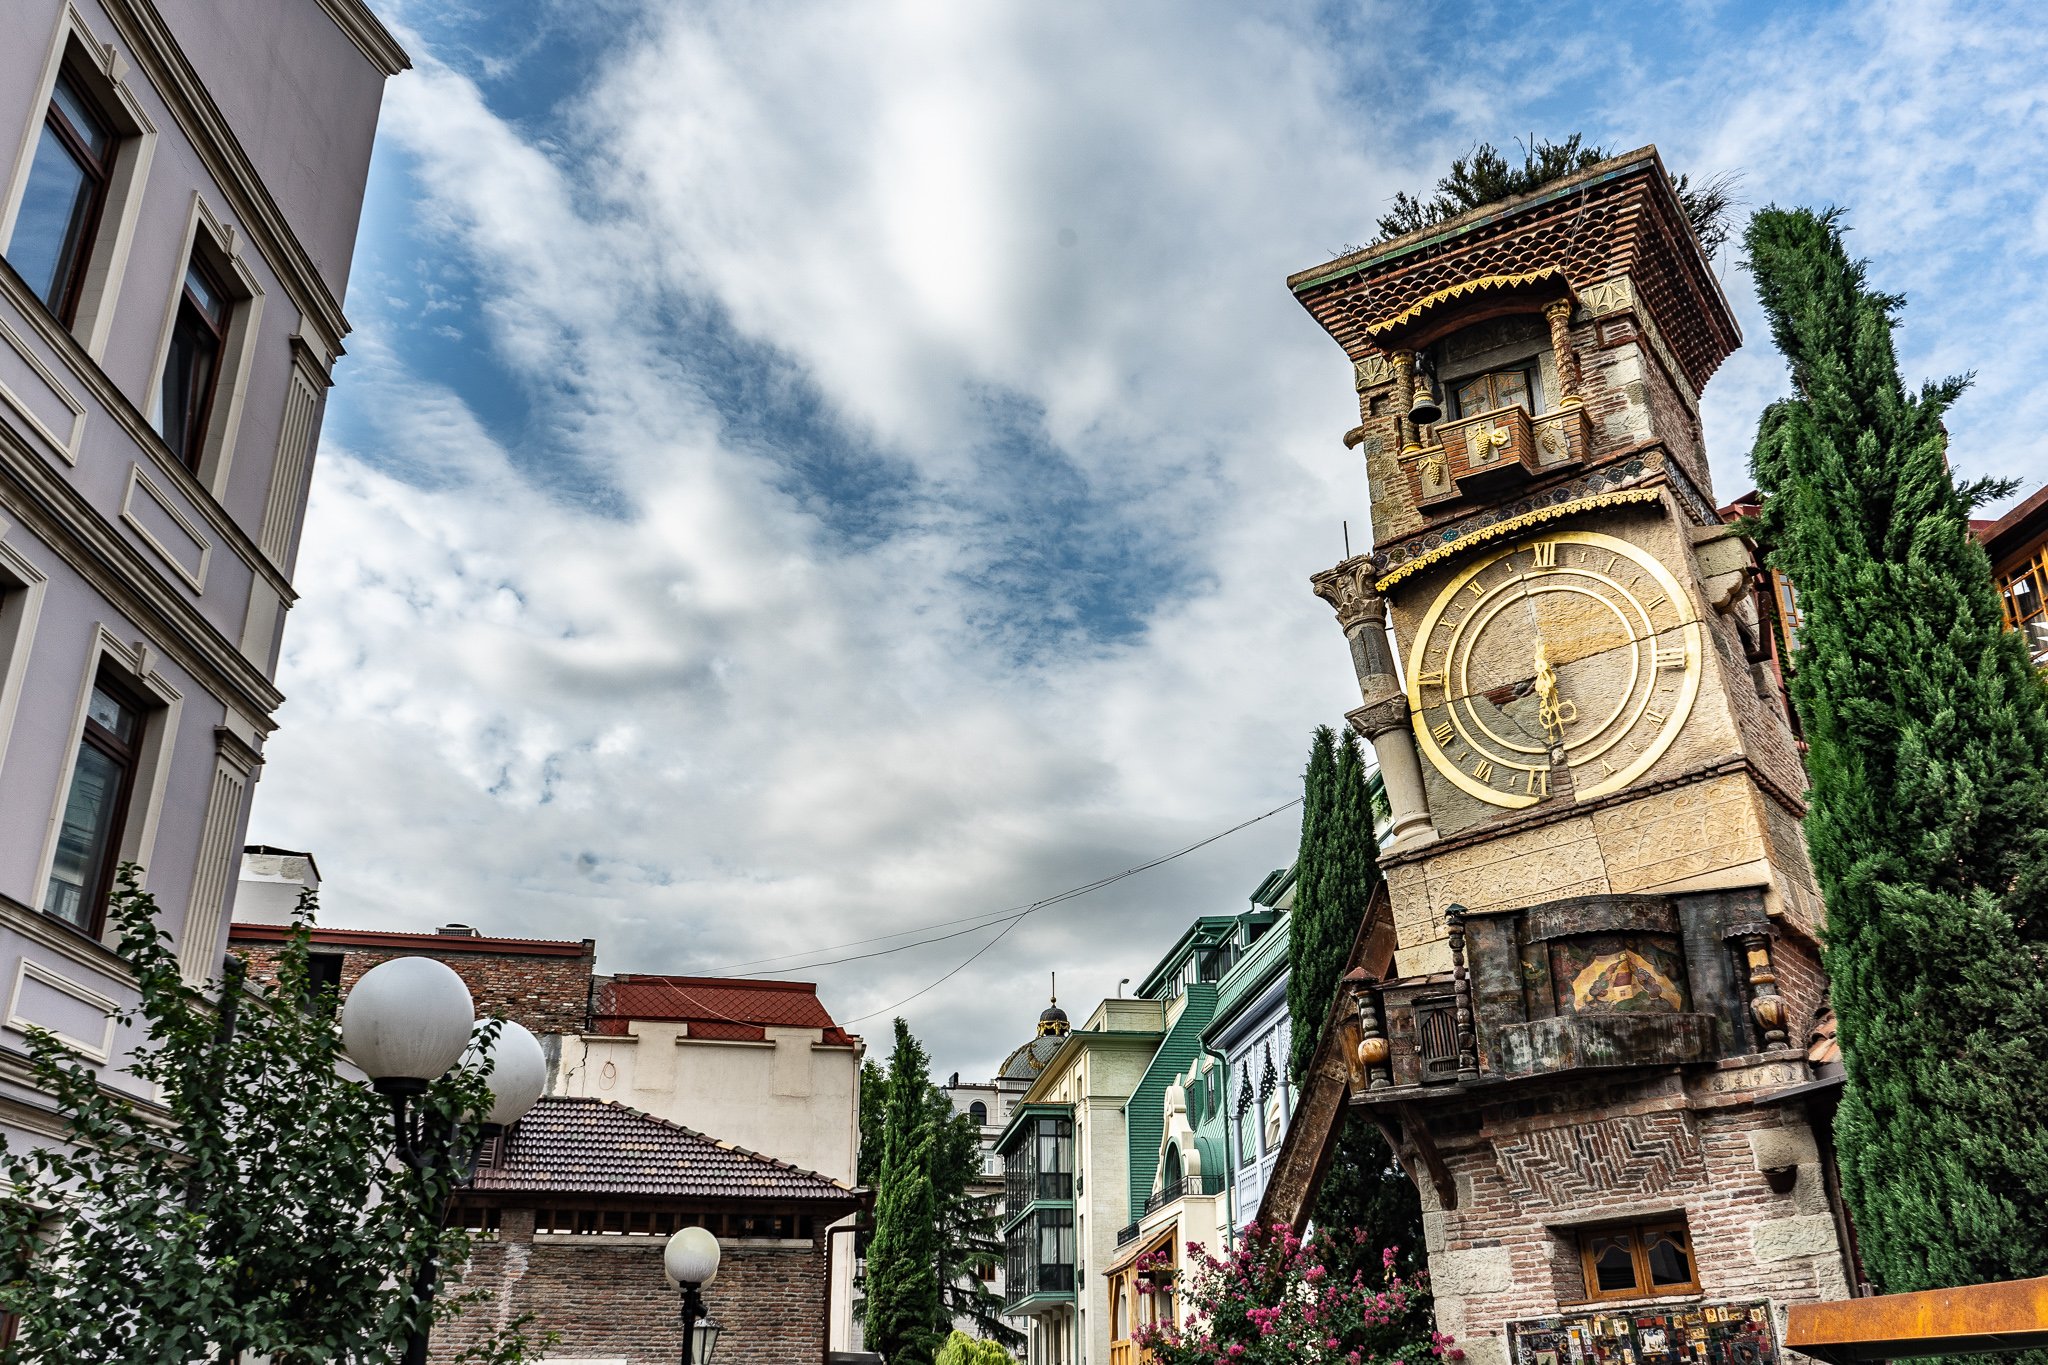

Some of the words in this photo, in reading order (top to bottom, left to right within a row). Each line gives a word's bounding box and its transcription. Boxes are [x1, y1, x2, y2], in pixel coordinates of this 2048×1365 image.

[1532, 542, 1557, 568] XII
[1467, 580, 1487, 599] XI
[1645, 594, 1666, 611] II
[1439, 617, 1458, 632] X
[1656, 646, 1685, 668] III
[1417, 667, 1444, 688] IX
[1645, 708, 1667, 731] IV
[1432, 720, 1456, 748] VIII
[1472, 759, 1494, 783] VII
[1601, 759, 1618, 780] V
[1524, 767, 1550, 796] VI
